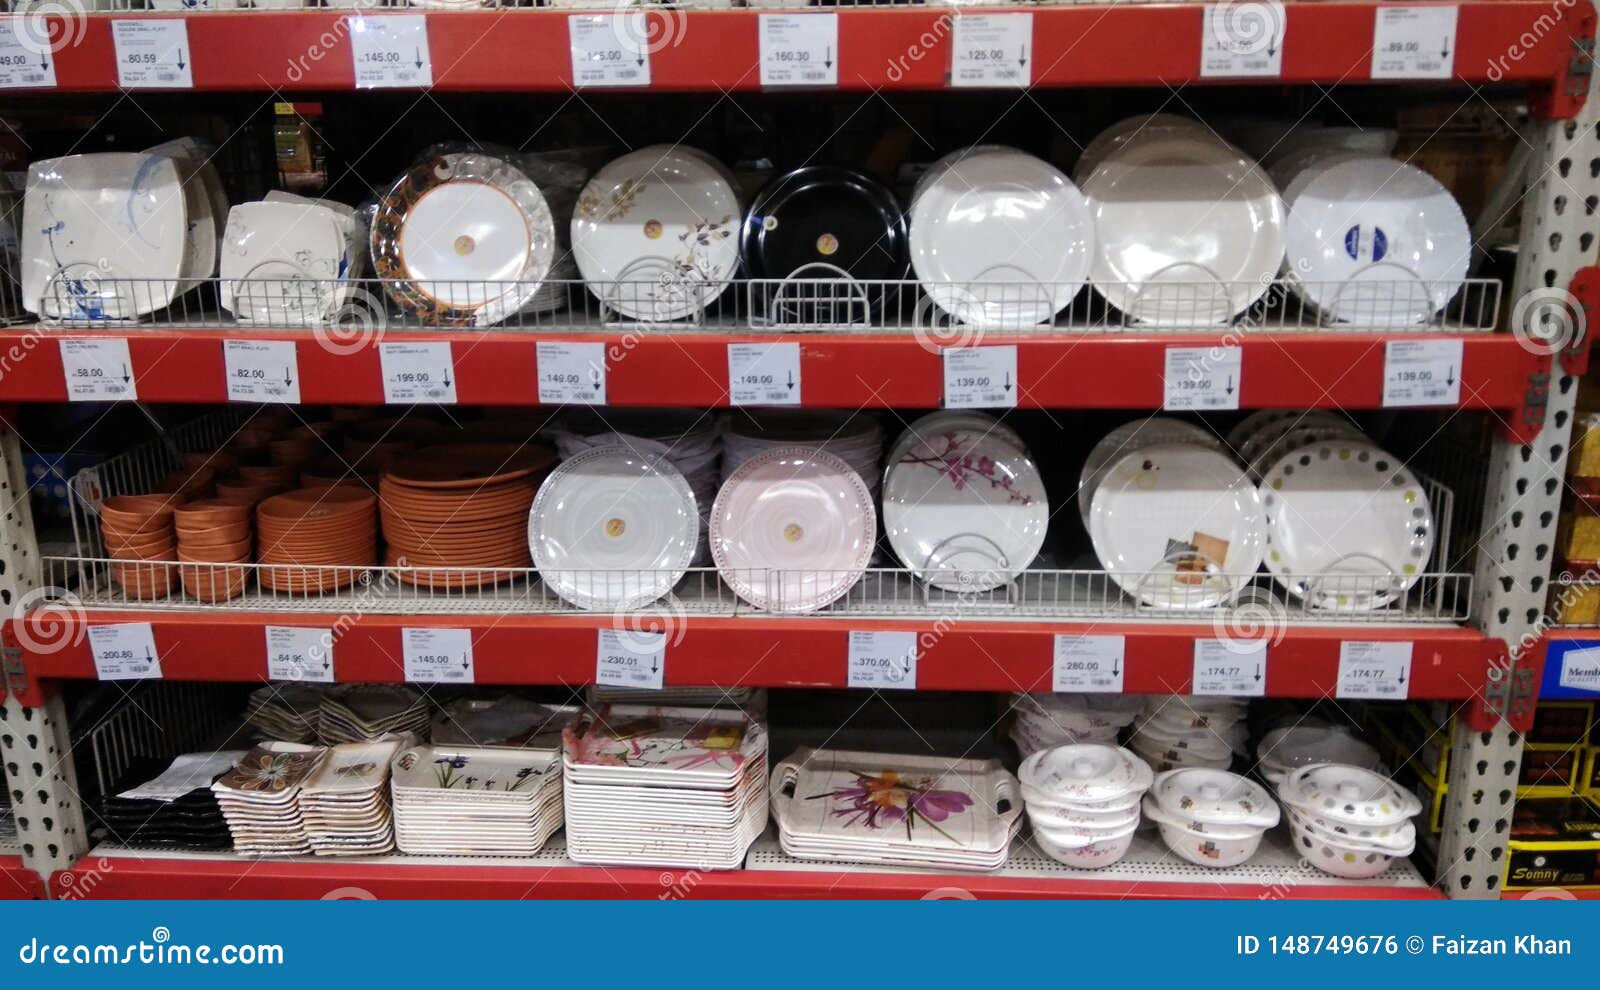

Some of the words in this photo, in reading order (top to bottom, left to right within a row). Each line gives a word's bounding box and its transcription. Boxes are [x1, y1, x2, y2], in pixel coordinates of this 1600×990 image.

[128, 53, 155, 64] 80.59
[365, 52, 399, 63] 145.00
[587, 50, 621, 61] 15.00
[775, 51, 809, 62] 160.30
[968, 49, 1003, 60] 125.00
[77, 368, 104, 378] 58.00
[237, 369, 265, 380] 82.00
[397, 373, 430, 383] 199.00
[1397, 371, 1432, 382] 139.00
[547, 374, 579, 384] 149.00
[741, 375, 773, 385] 149.00
[957, 377, 990, 388] 139.00
[1176, 380, 1212, 390] 139.00
[418, 655, 449, 664] 145.00
[607, 656, 638, 666] 230.01
[859, 658, 890, 667] 370.00
[1067, 662, 1099, 671] 280.00
[1208, 668, 1240, 676] 174.77
[1353, 670, 1385, 679] 174.77
[1512, 868, 1559, 881] Somny
